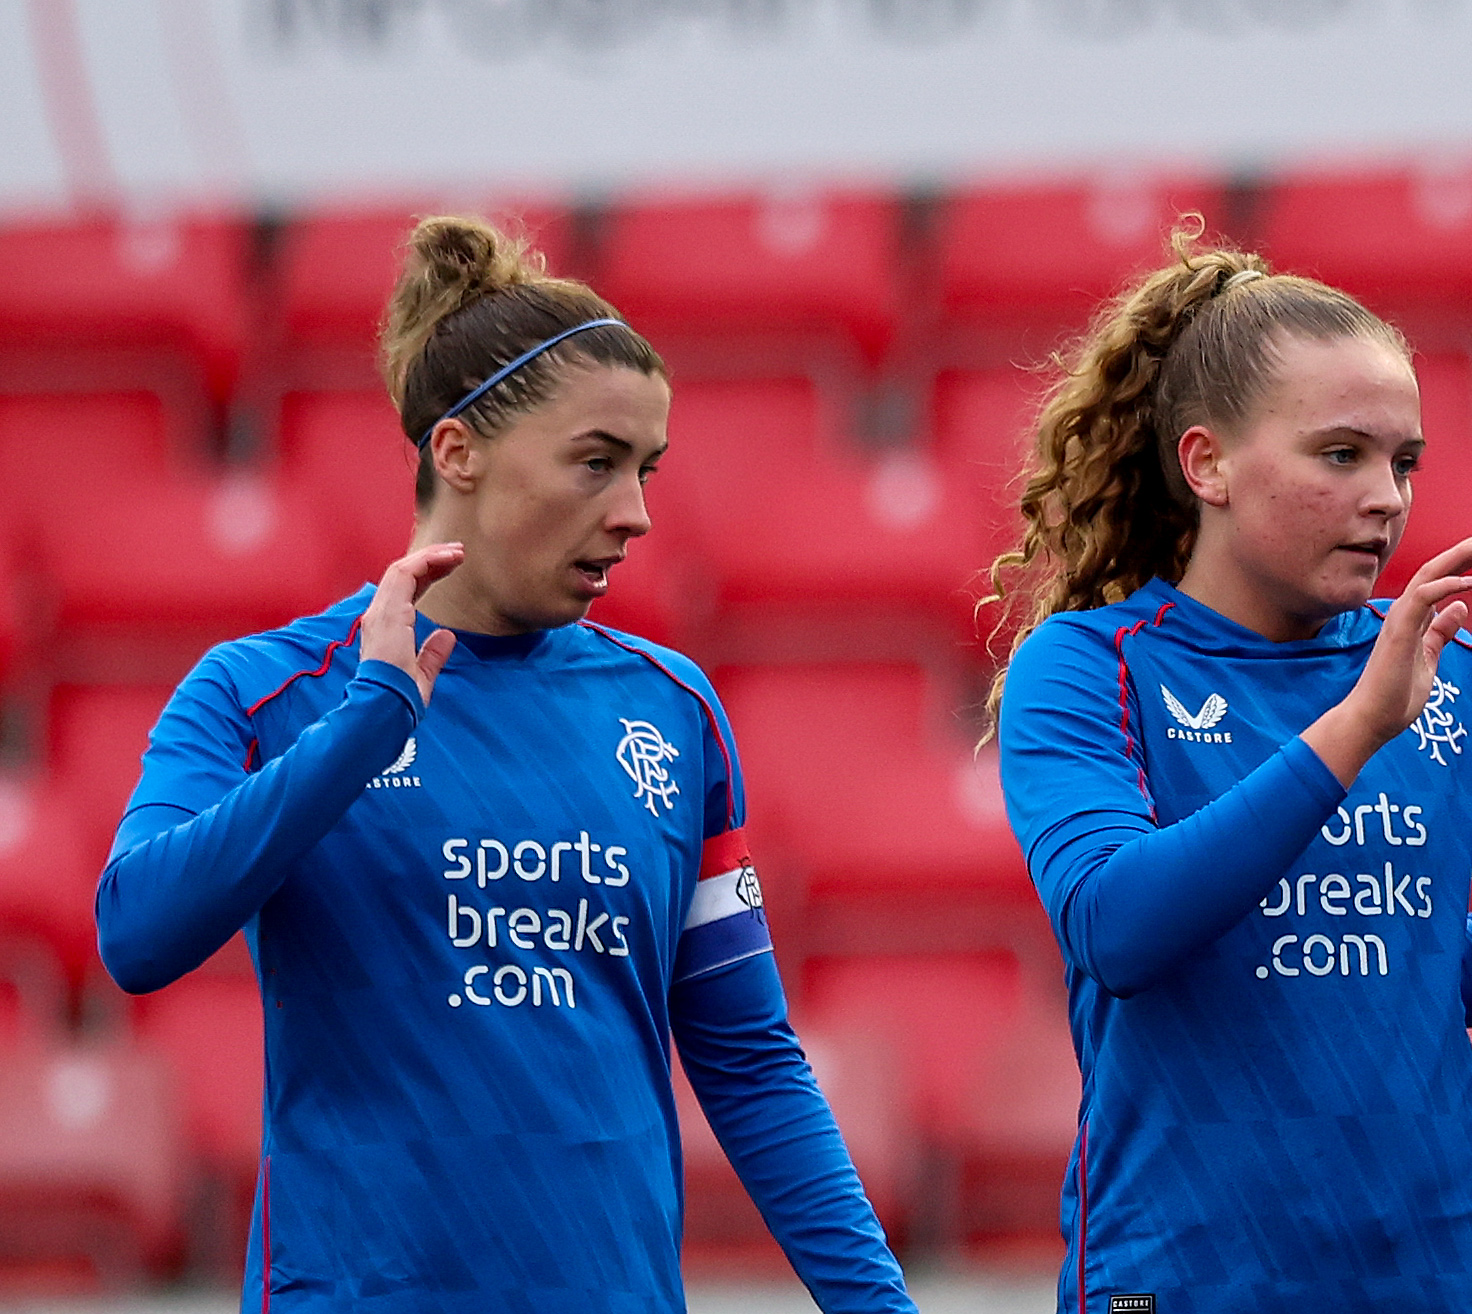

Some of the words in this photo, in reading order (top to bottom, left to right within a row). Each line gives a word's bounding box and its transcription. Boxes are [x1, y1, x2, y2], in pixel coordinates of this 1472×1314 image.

[1167, 727, 1232, 744] CASTORE
[366, 775, 422, 789] STORE
[1320, 792, 1428, 846] orts
[442, 830, 630, 888] sports
[447, 893, 630, 957] breaks
[1255, 933, 1389, 980] .com
[447, 964, 576, 1009] .com
